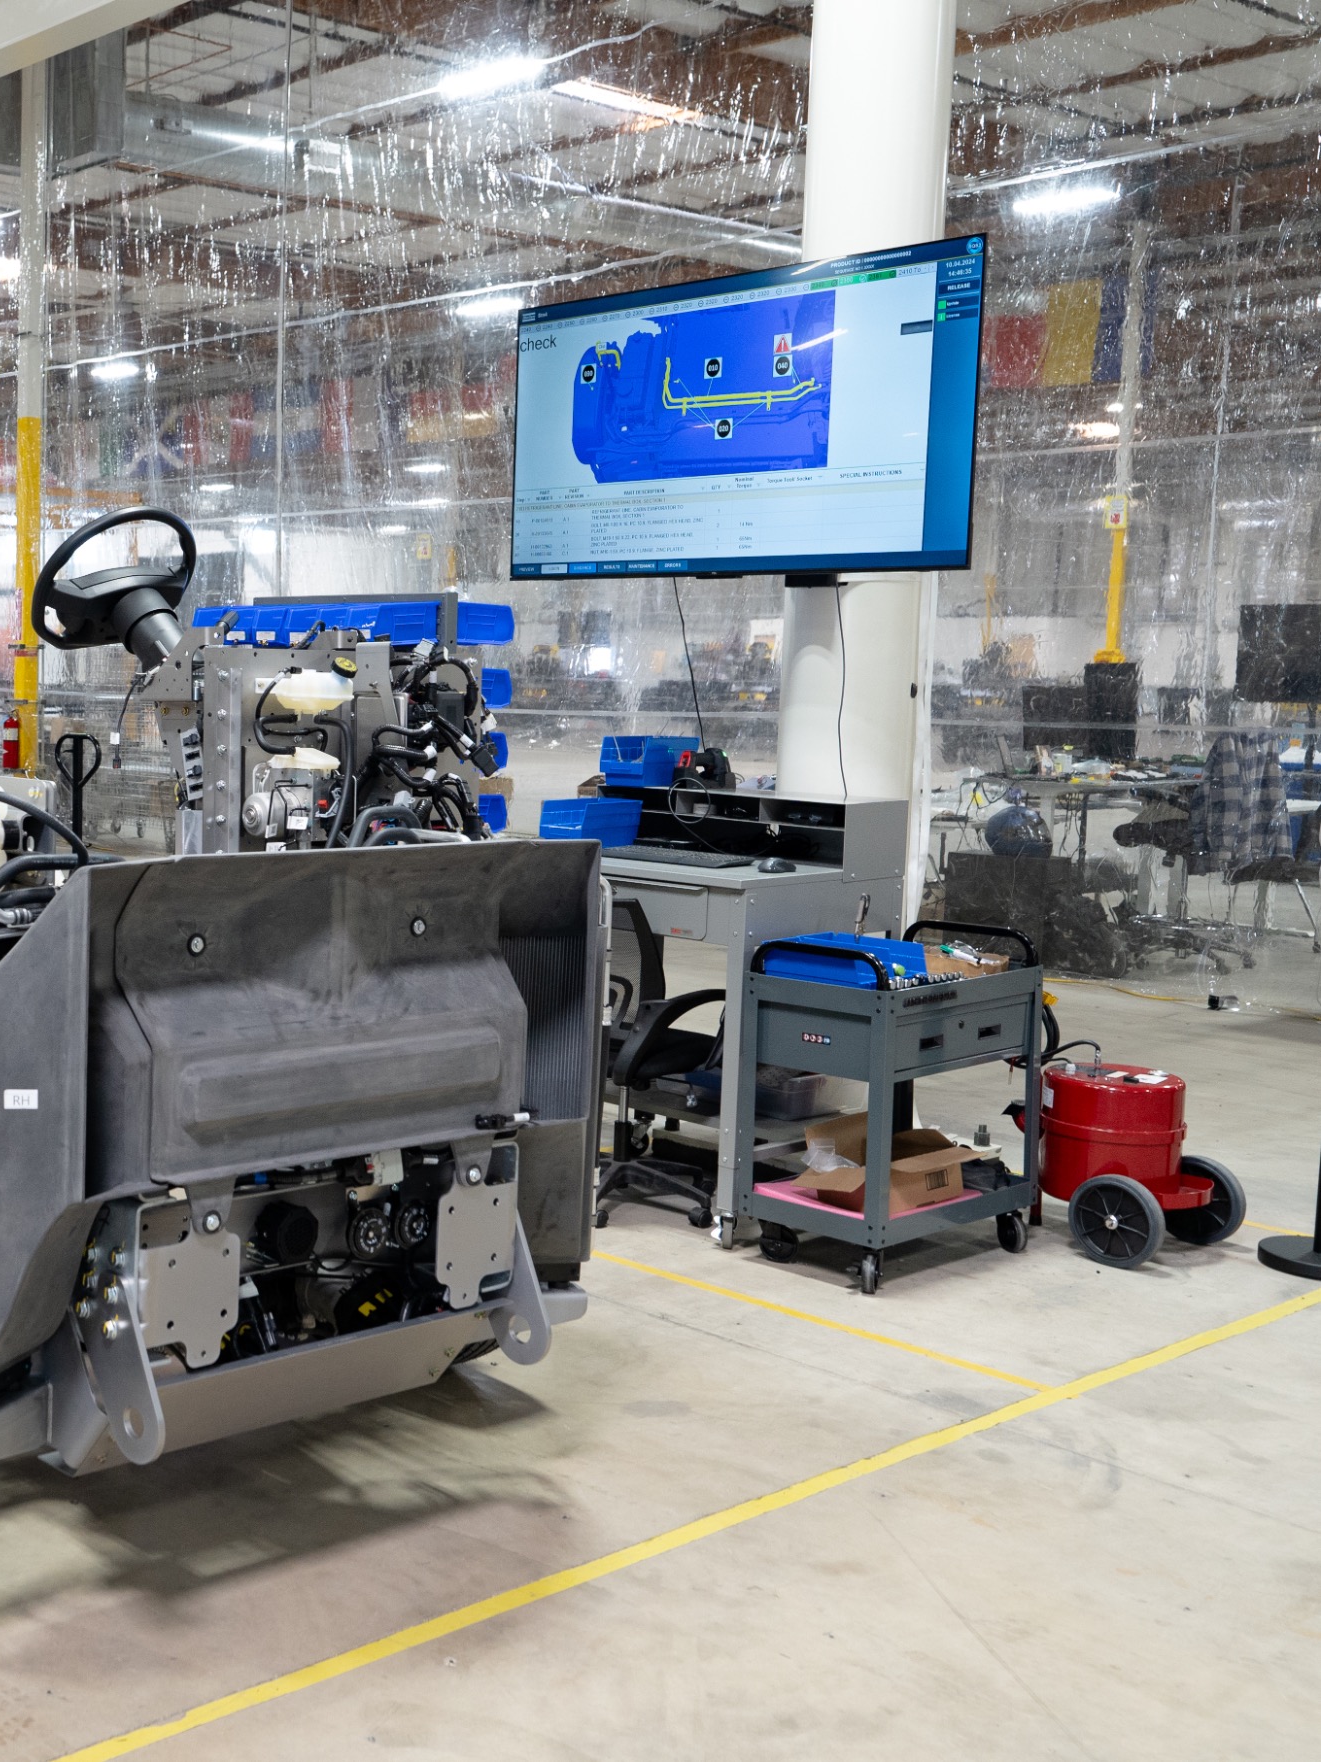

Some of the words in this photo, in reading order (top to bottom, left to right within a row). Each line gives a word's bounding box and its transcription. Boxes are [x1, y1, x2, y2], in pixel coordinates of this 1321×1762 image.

[831, 260, 854, 268] PRODUCT
[898, 268, 912, 276] 2410
[947, 282, 971, 291] RELEASE
[520, 334, 557, 352] check
[707, 364, 719, 372] 010
[777, 362, 789, 370] 040
[863, 469, 903, 477] INSTRUCTIONS
[13, 1095, 30, 1106] RH
